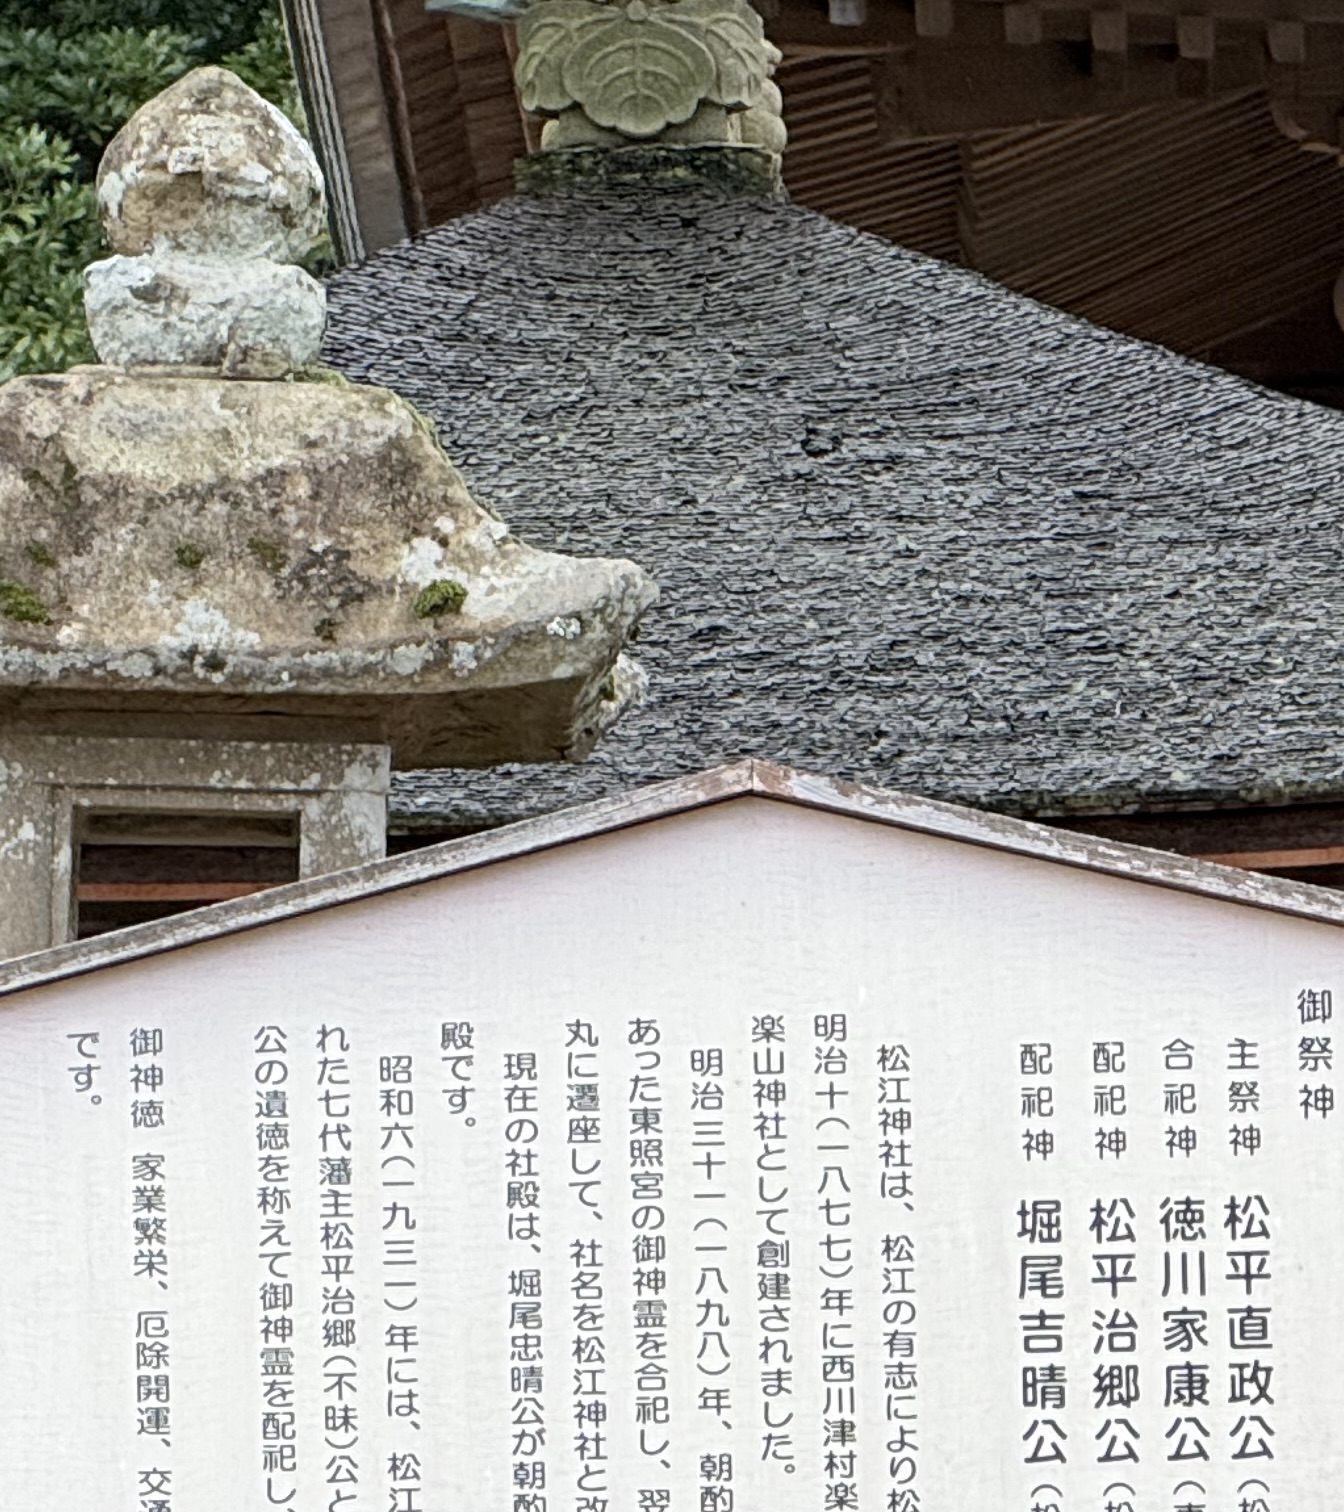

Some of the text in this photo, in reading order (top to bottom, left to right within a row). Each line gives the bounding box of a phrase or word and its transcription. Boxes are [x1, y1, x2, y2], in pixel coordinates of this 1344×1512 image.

[66, 1032, 103, 1106] です。
[129, 1027, 165, 1129] 御神徳
[440, 1021, 477, 1128] 殿です。
[1019, 1042, 1054, 1162] 配祀神
[1092, 1041, 1127, 1161] 配祀神
[1161, 1037, 1197, 1159] 合祀神
[1226, 1037, 1262, 1157] 主祭神
[1297, 988, 1335, 1121] 御祭神
